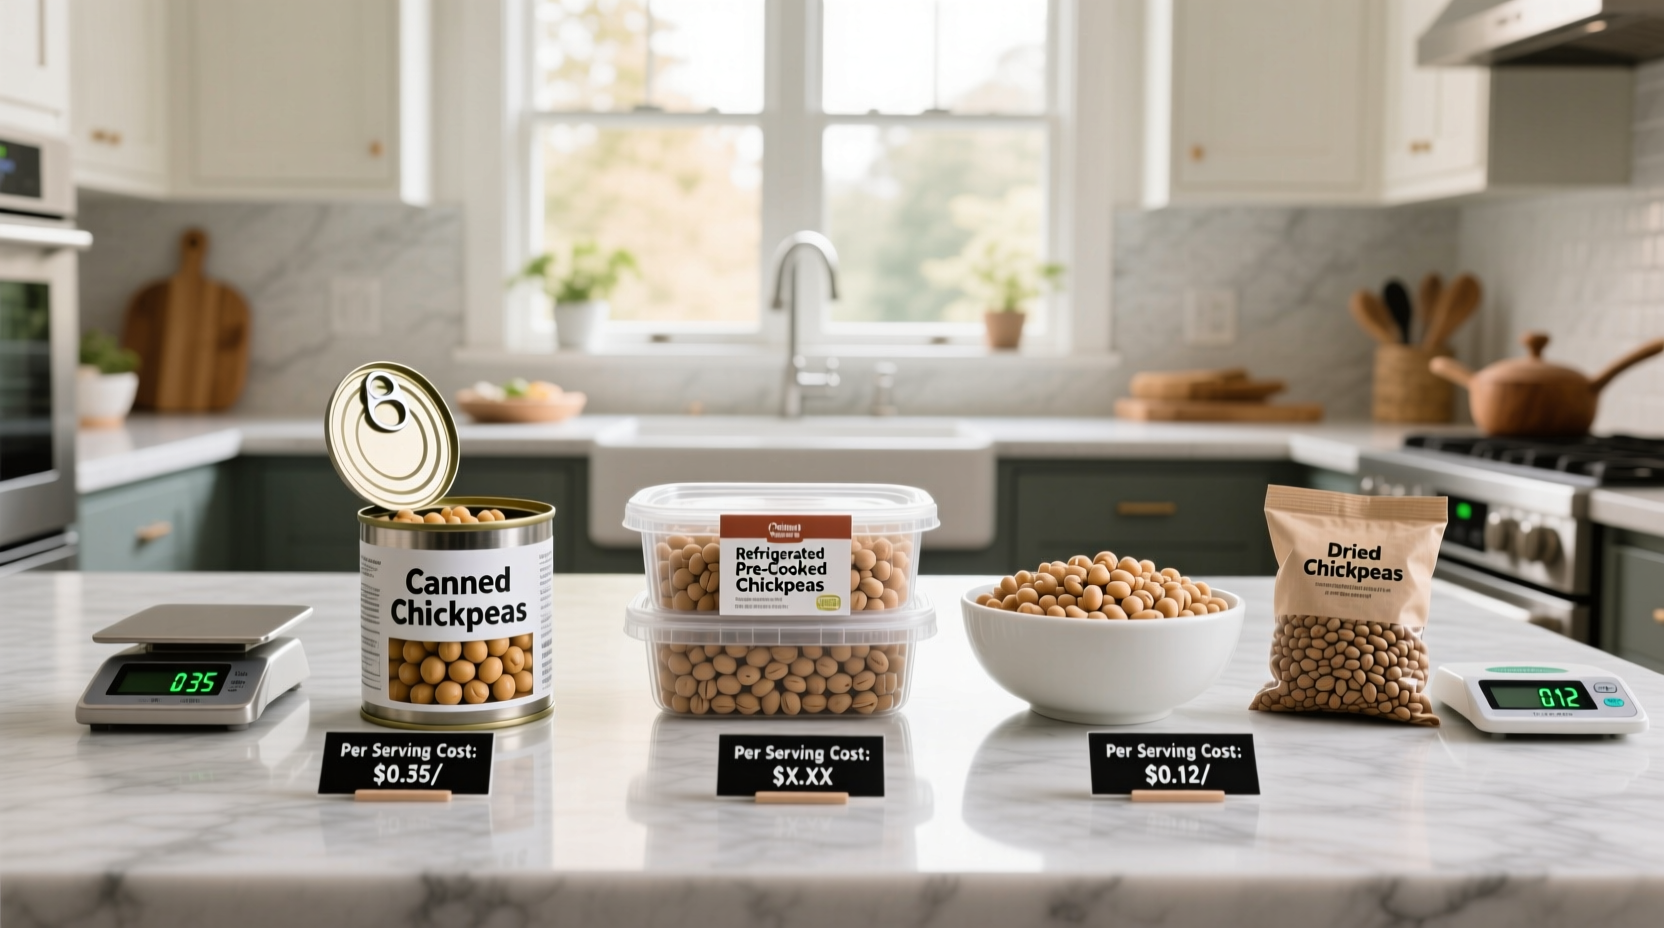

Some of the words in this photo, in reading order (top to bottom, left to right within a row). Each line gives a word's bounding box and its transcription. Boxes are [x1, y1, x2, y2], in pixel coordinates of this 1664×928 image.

[736, 546, 825, 563] Refrigerated
[1328, 542, 1381, 561] Dried
[735, 560, 827, 576] Pre-Cooked
[1303, 558, 1404, 583] Chickpeas
[405, 566, 511, 595] Canned
[735, 577, 825, 596] Chickpeas
[390, 598, 527, 633] Chickpeas
[340, 742, 368, 758] Per
[371, 742, 432, 761] Serving
[436, 743, 477, 759] Cost:
[734, 745, 762, 760] Per
[765, 744, 825, 764] Serving
[829, 745, 871, 762] Cost:
[1106, 743, 1133, 758] Per
[1137, 742, 1197, 762] Serving
[1201, 743, 1242, 759] Cost:
[373, 762, 444, 787] $0.35/
[772, 765, 834, 788] $X.XX
[1145, 763, 1211, 787] $0.12/
